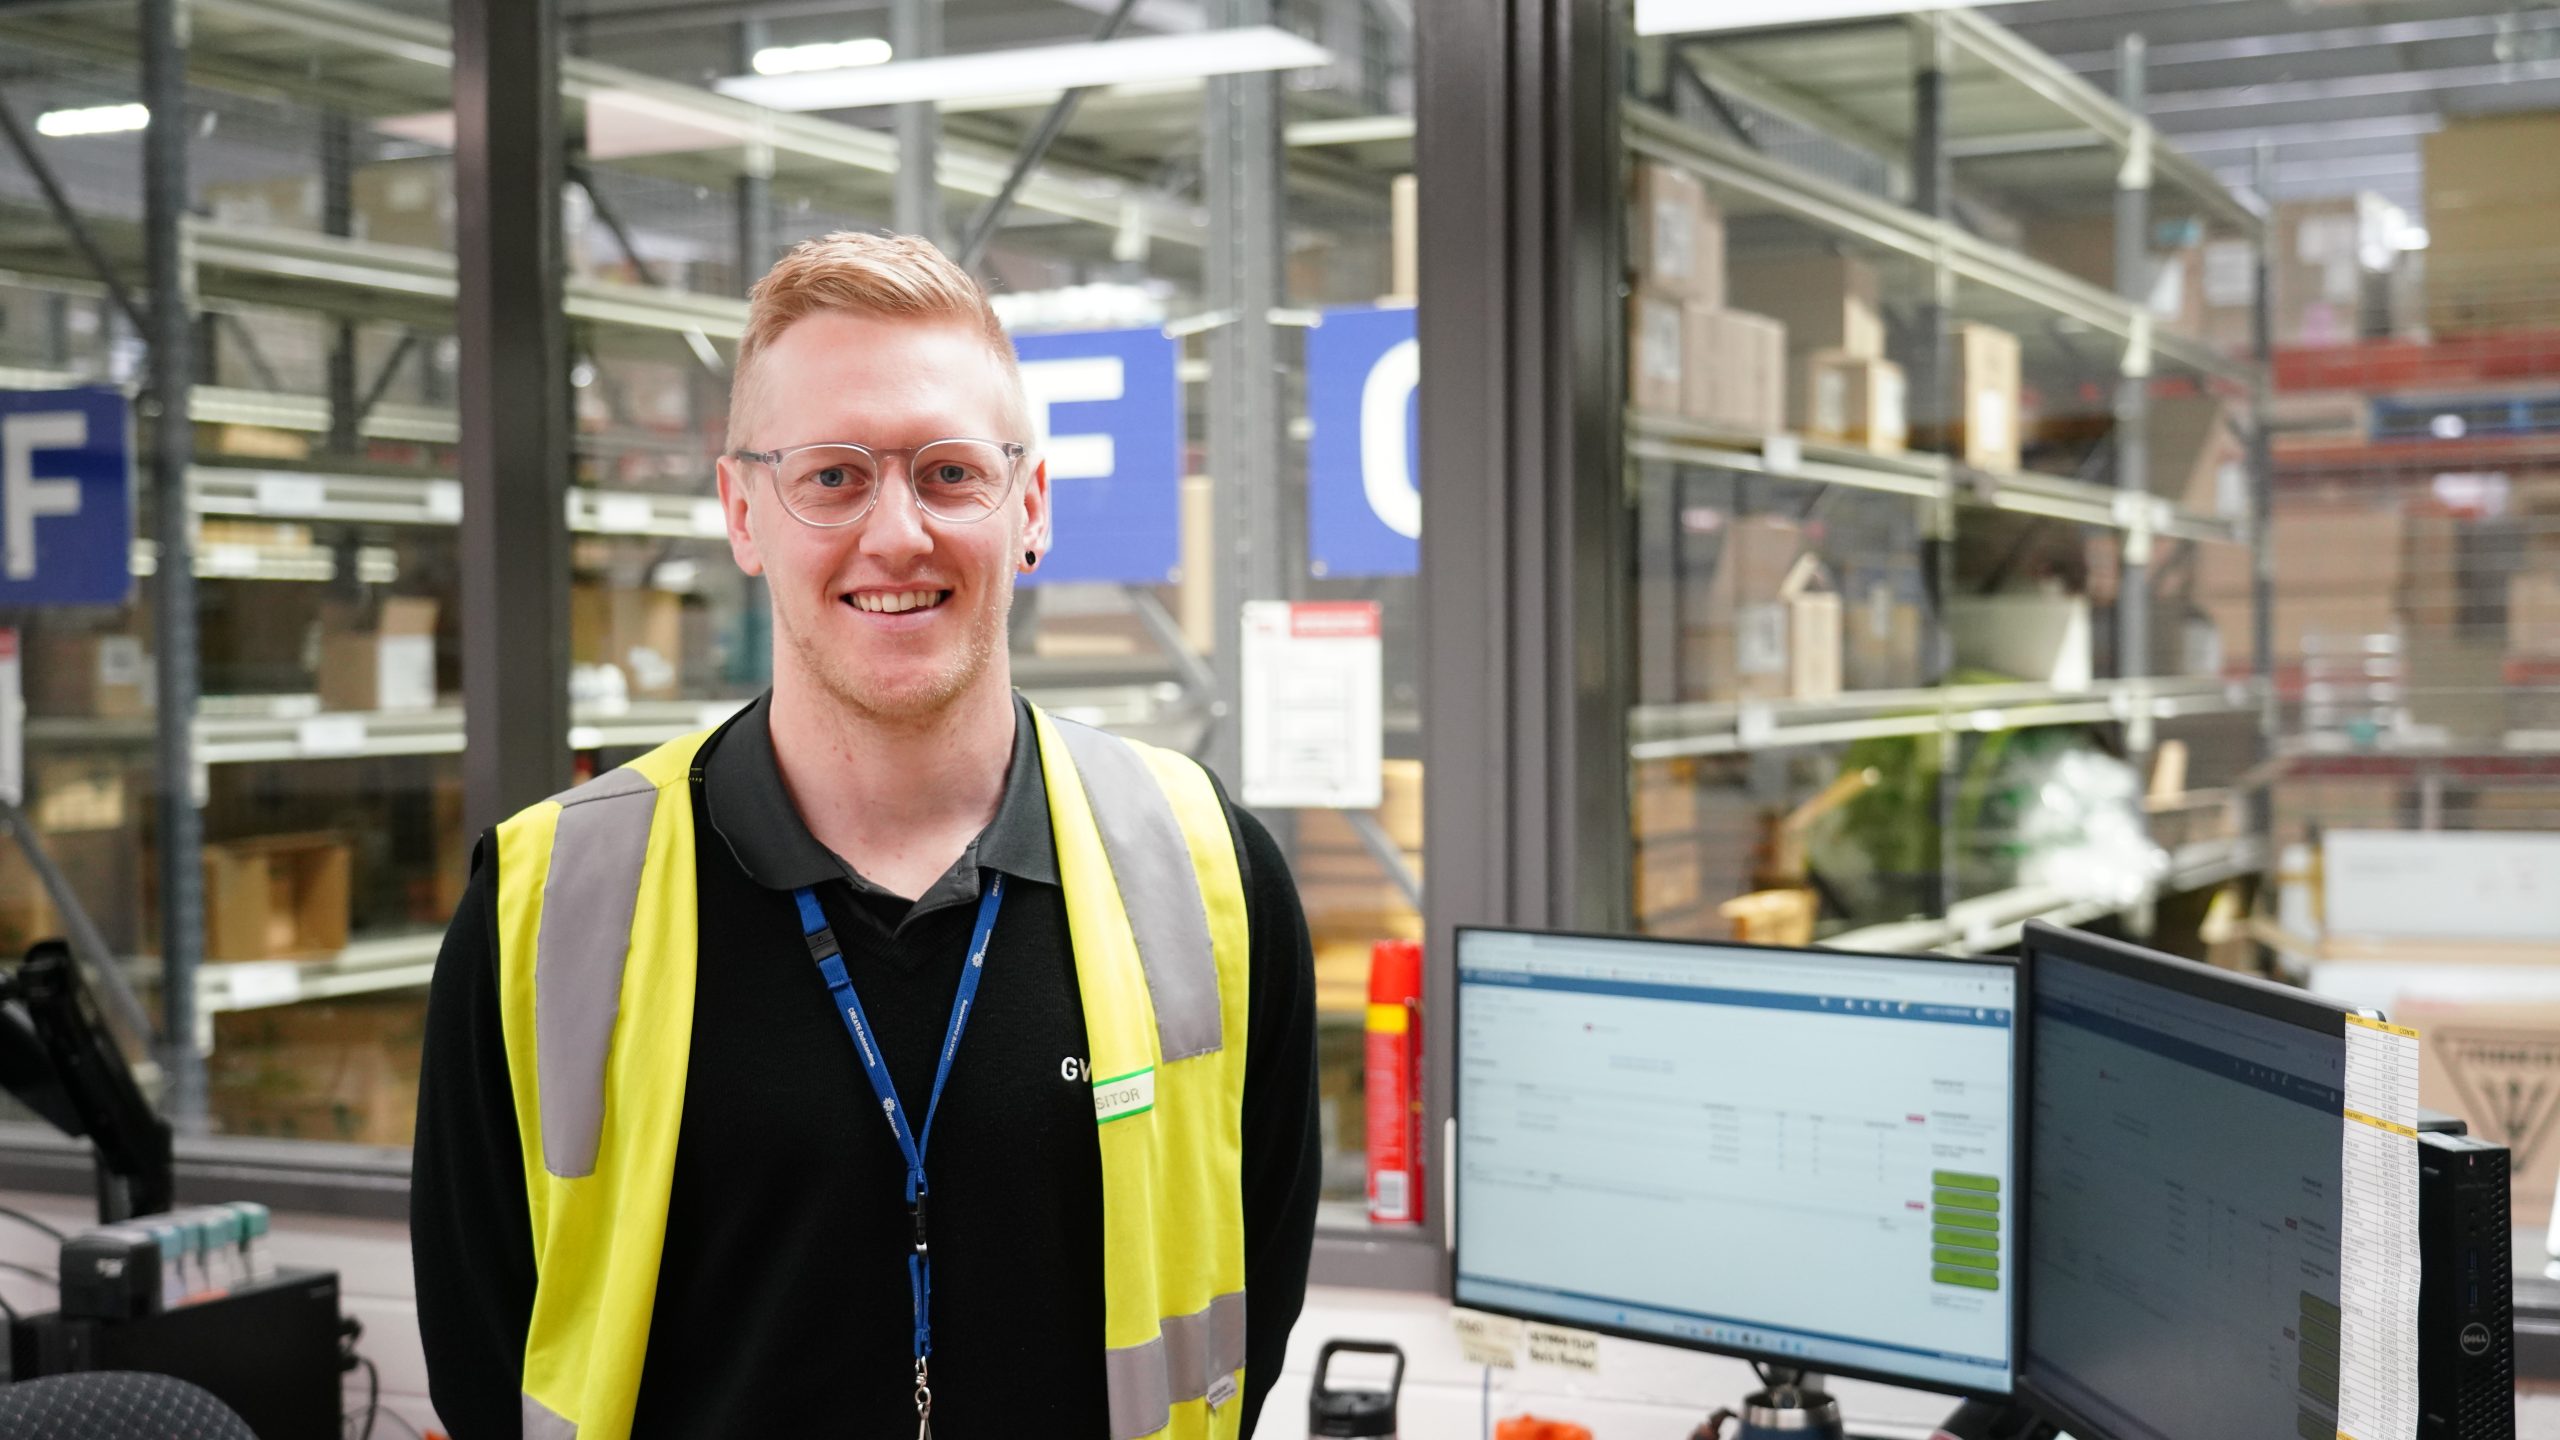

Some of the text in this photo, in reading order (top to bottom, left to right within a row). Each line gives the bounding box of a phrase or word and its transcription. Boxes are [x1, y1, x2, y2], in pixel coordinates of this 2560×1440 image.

[1020, 356, 1124, 552] F
[3, 411, 88, 581] F
[1061, 1057, 1091, 1082] GV
[1095, 1088, 1140, 1110] SITOR
[2463, 1334, 2486, 1345] DELL
